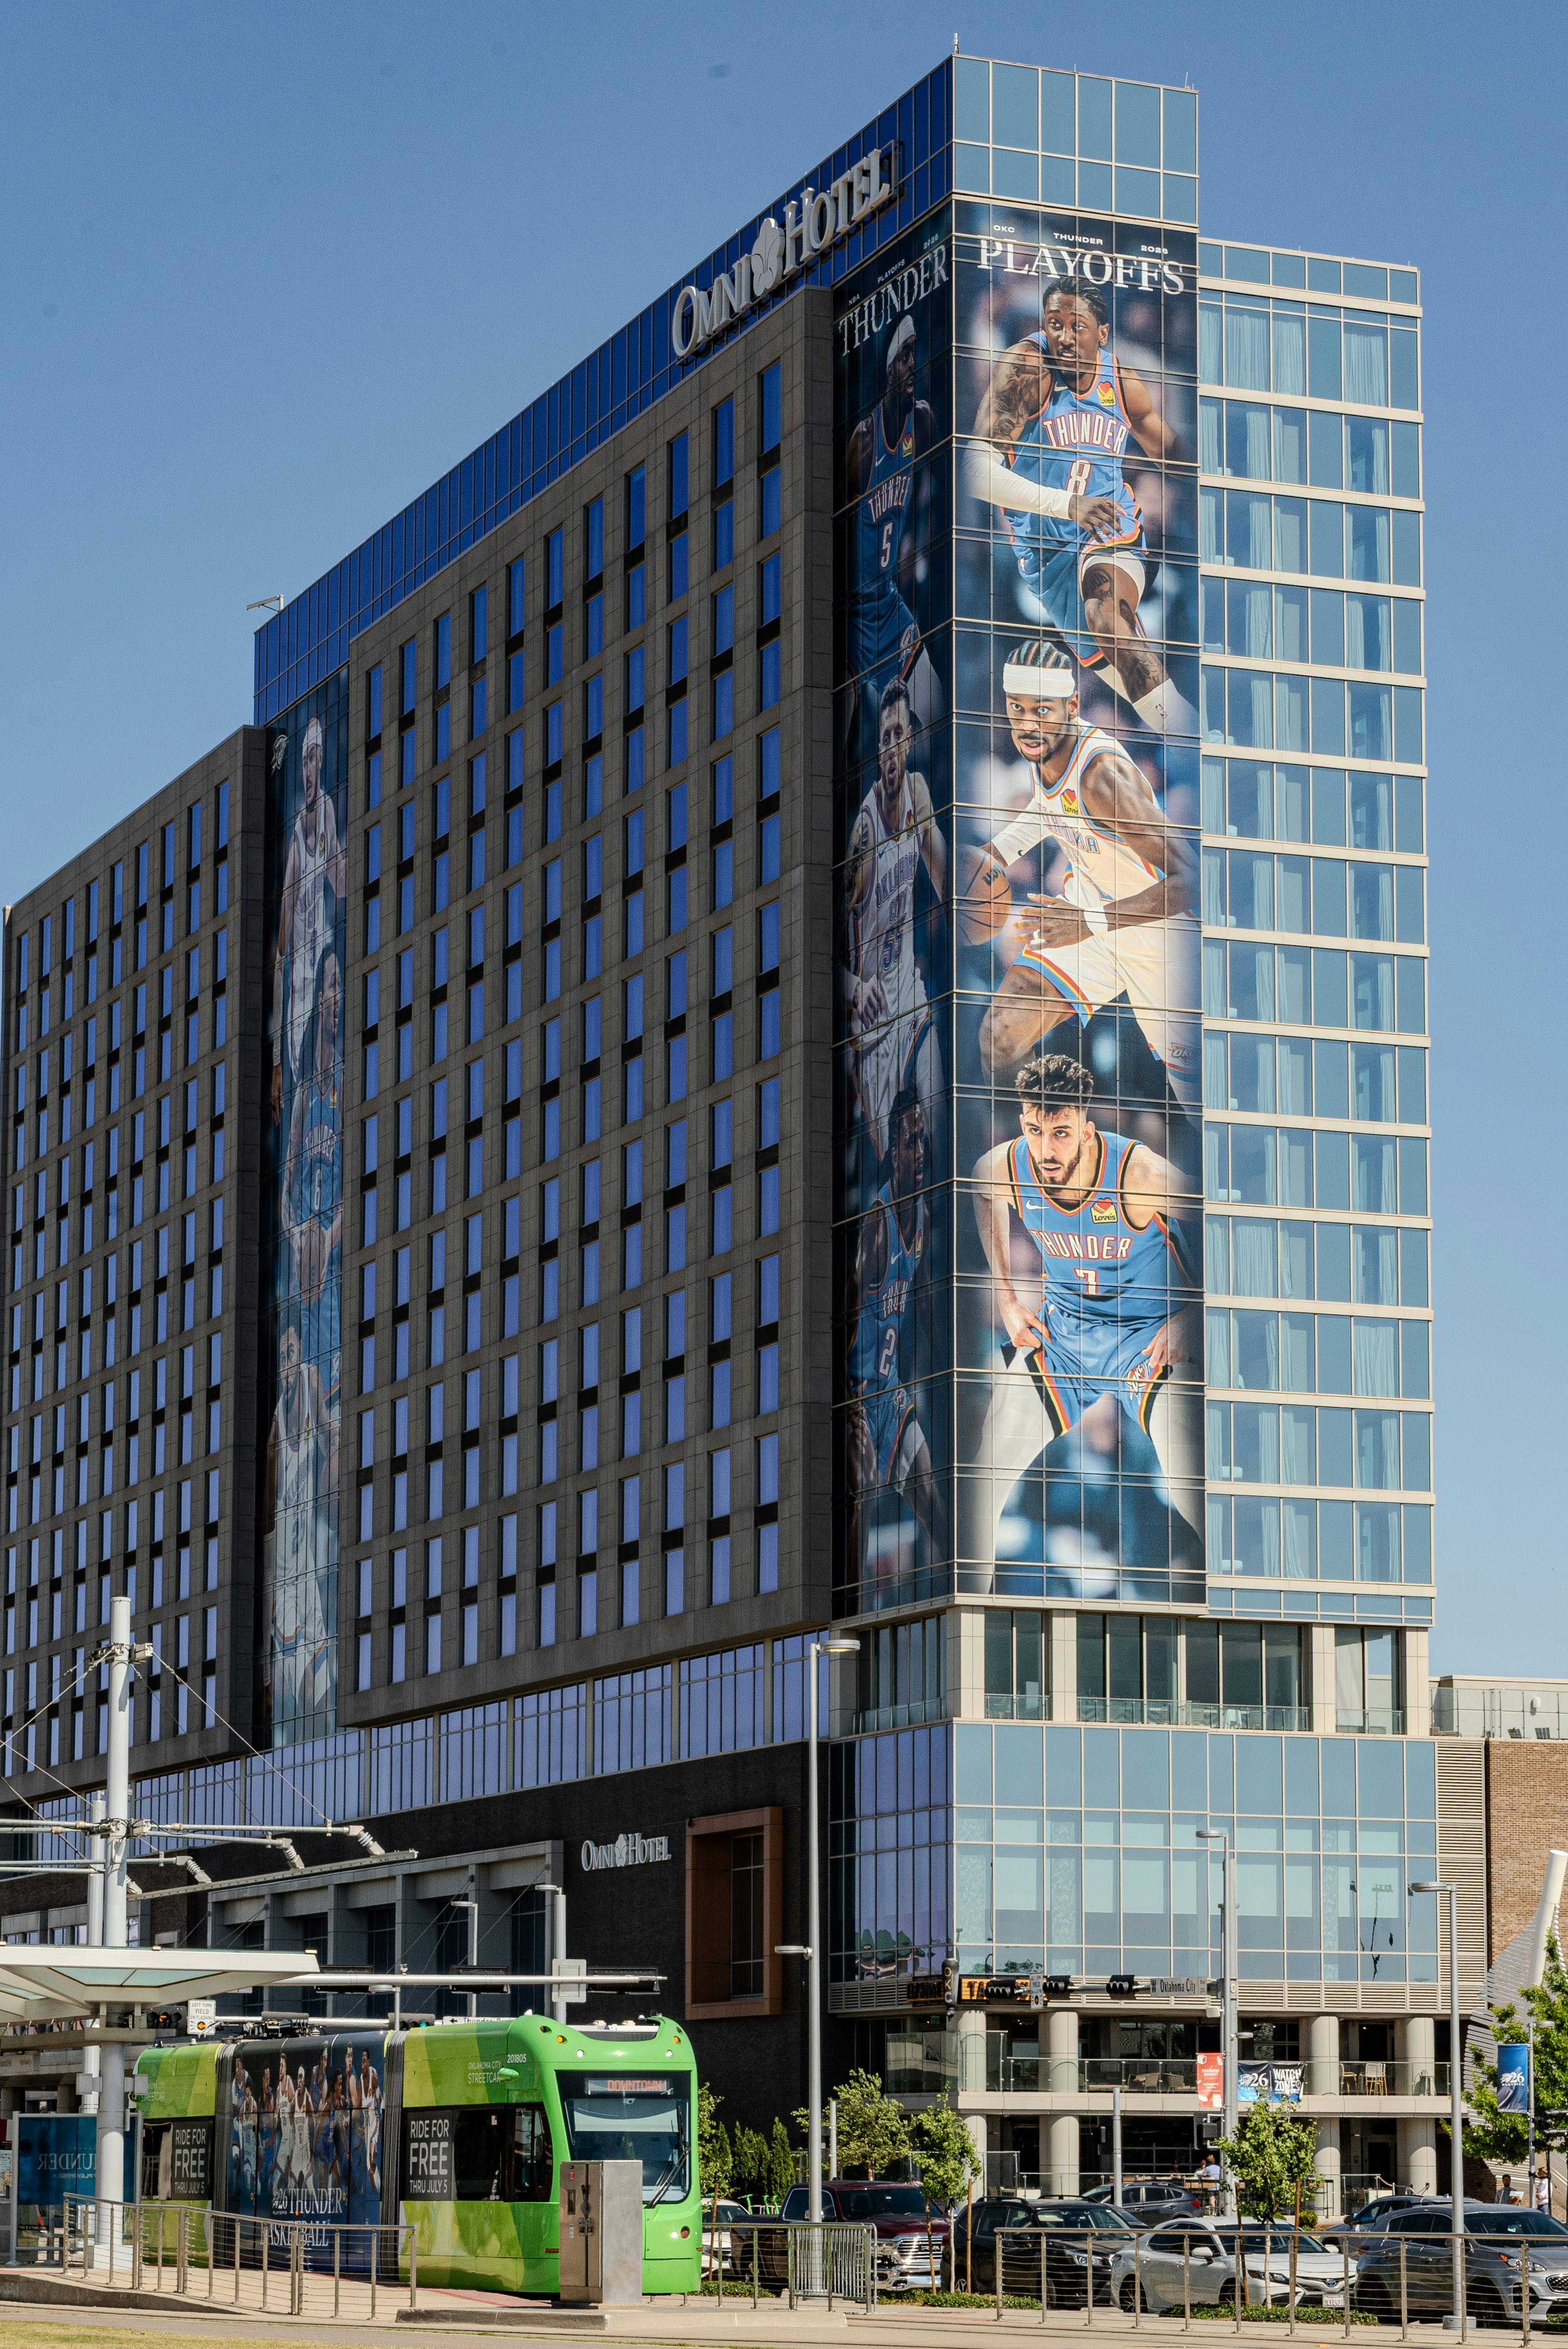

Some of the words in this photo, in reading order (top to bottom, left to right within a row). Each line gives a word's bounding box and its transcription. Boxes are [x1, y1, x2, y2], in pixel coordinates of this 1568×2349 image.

[673, 254, 752, 357] OMNI
[783, 148, 891, 276] HOTEL
[993, 224, 1015, 233] OKC
[1052, 232, 1103, 245] THUNDER
[1141, 244, 1168, 255] 2026
[848, 294, 860, 306] NBA
[877, 259, 905, 284] PLAYOFFS
[923, 233, 939, 250] 2026
[977, 235, 1184, 295] PLAYOFFS
[838, 244, 949, 357] THUNDER
[1042, 412, 1128, 455] THUNDER
[1065, 458, 1093, 497] 8
[880, 522, 894, 569] 5
[1028, 1228, 1133, 1261] THUNDER
[1073, 1268, 1099, 1296] 7
[878, 1325, 896, 1379] 2
[581, 1840, 616, 1871] OMNI
[627, 1833, 672, 1865] HOTEL
[1151, 1979, 1156, 1993] W
[1160, 1979, 1184, 1993] Oklahoma
[1186, 1978, 1196, 1994] City
[468, 2061, 490, 2070] OKLAHOMA
[507, 2054, 526, 2063] 201805
[468, 2071, 501, 2084] STREETCAR
[607, 2080, 662, 2092] DOWNTOWN
[1250, 2073, 1268, 2087] 26
[1273, 2068, 1302, 2081] WATCH
[1274, 2080, 1296, 2092] ZONE
[1510, 2072, 1525, 2083] 26
[175, 2129, 191, 2145] RIDE
[192, 2129, 206, 2144] FOR
[411, 2120, 429, 2138] RIDE
[431, 2119, 449, 2137] FOR
[175, 2148, 206, 2178] FREE
[410, 2141, 448, 2176] FREE
[175, 2182, 188, 2194] THRU
[188, 2181, 200, 2194] JULY
[201, 2182, 205, 2194] 5
[410, 2180, 426, 2193] THRU
[427, 2179, 442, 2193] JULY
[443, 2179, 447, 2193] 5
[288, 2187, 343, 2214] THUNDER
